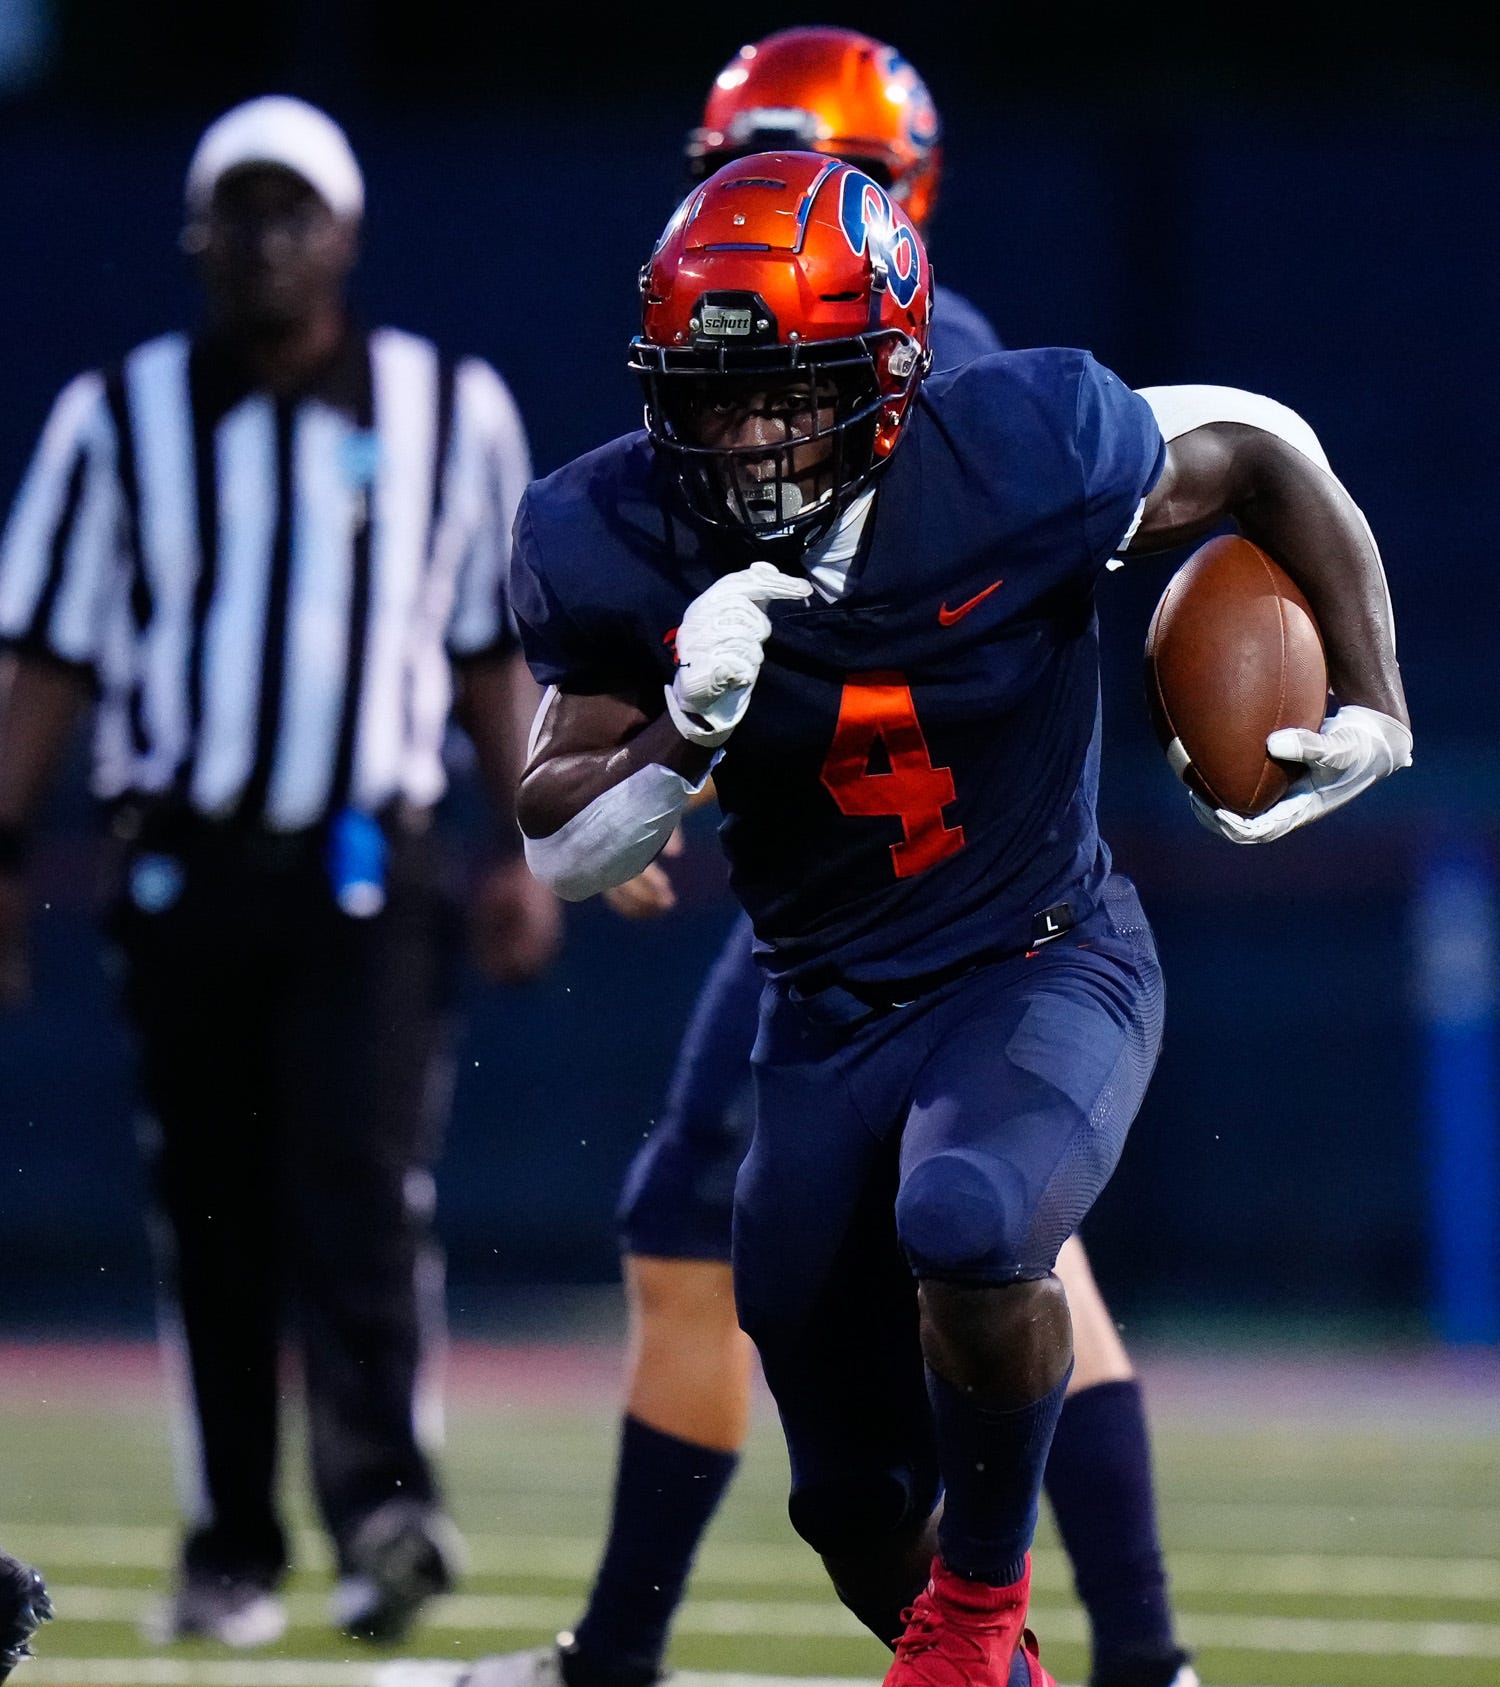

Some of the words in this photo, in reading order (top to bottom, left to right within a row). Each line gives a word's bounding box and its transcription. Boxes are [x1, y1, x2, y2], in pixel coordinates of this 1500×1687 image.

[704, 316, 750, 334] schutt
[820, 670, 967, 878] 4
[1046, 915, 1059, 932] L
